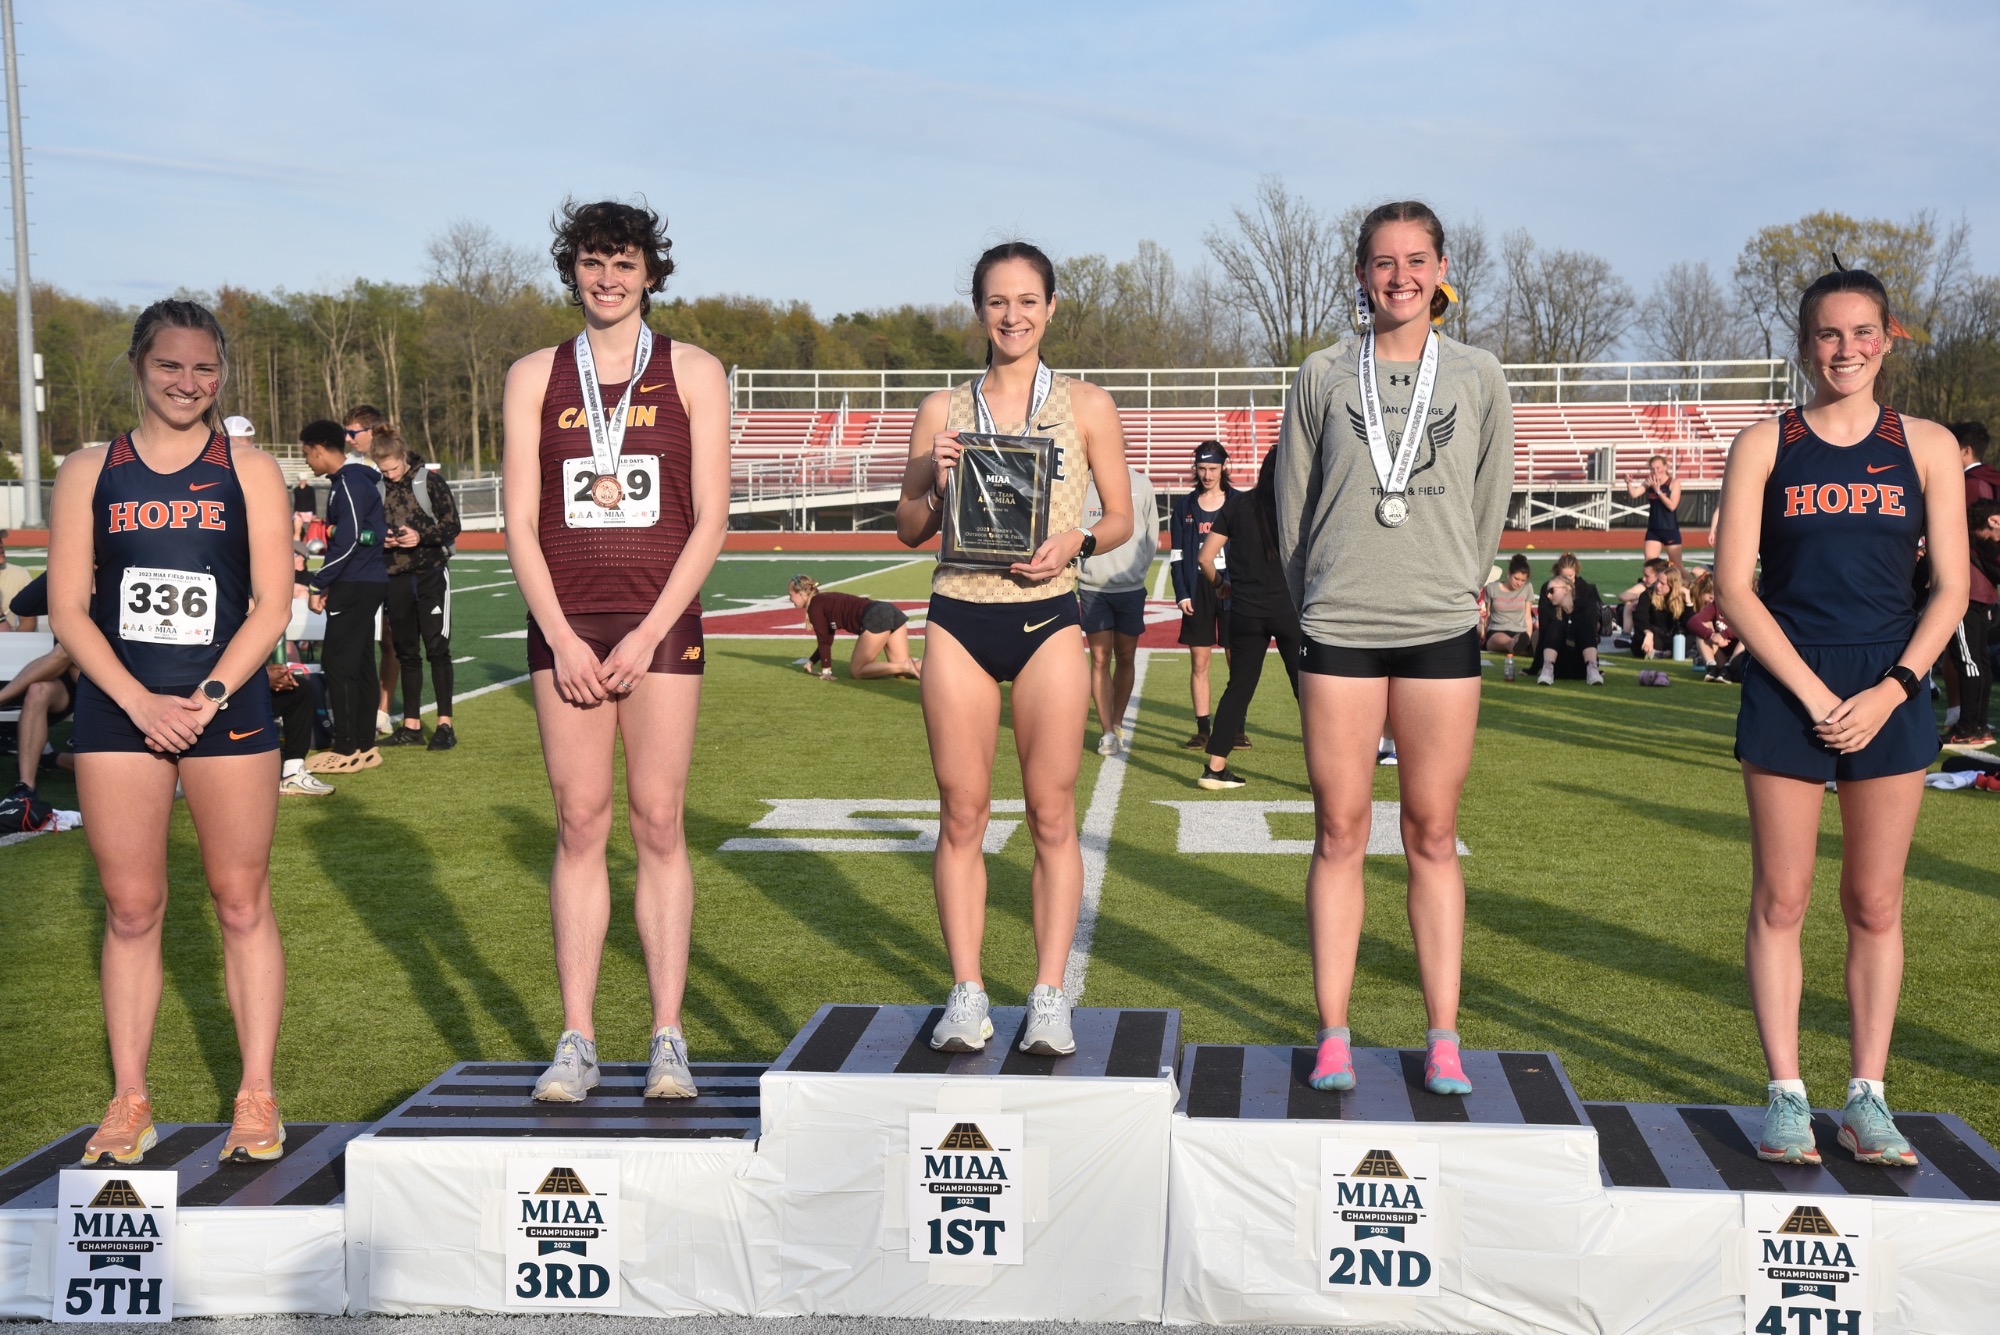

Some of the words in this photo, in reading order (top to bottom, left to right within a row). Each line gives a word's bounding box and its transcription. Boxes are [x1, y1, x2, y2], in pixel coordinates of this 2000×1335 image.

[574, 469, 651, 502] 29
[986, 474, 1011, 484] MIAA
[1418, 486, 1445, 495] FIELD
[1783, 483, 1906, 518] HOPE
[108, 500, 226, 534] HOPE
[128, 582, 208, 618] 336
[155, 626, 178, 635] MIAA
[923, 1155, 1009, 1180] MIAA
[933, 1184, 998, 1193] CHAMPIONSHIP
[1337, 1182, 1424, 1209] MIAA
[521, 1199, 605, 1224] MIAA
[1346, 1212, 1413, 1222] CHAMPIONSHIP
[73, 1212, 161, 1238] MIAA
[530, 1228, 595, 1237] CHAMPIONSHIP
[927, 1218, 1006, 1256] 1ST
[1370, 1226, 1389, 1234] 2023
[82, 1243, 150, 1251] CHAMPIONSHIP
[1762, 1238, 1857, 1268] MIAA
[1328, 1246, 1432, 1288] 2ND
[1772, 1269, 1846, 1281] CHAMPIONSHIP
[515, 1262, 611, 1299] 3RD
[1799, 1284, 1819, 1293] 2023
[65, 1277, 163, 1316] 5TH
[1755, 1305, 1862, 1335] 4TH
